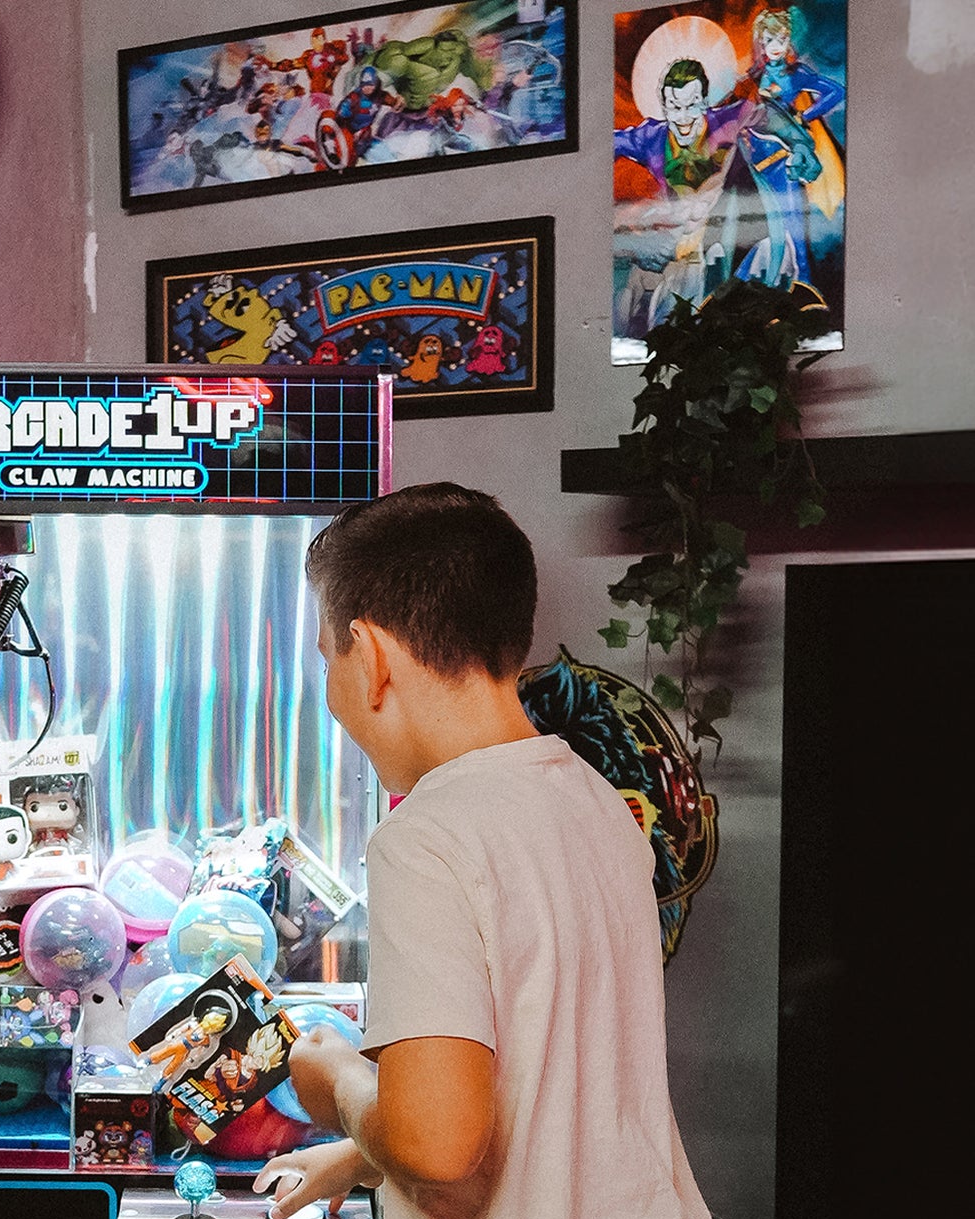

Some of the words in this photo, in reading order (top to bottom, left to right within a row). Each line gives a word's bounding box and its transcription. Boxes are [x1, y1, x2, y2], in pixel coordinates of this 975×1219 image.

[327, 271, 483, 316] PAC-MAN
[8, 467, 77, 487] CLAW
[87, 468, 196, 488] MACHINE
